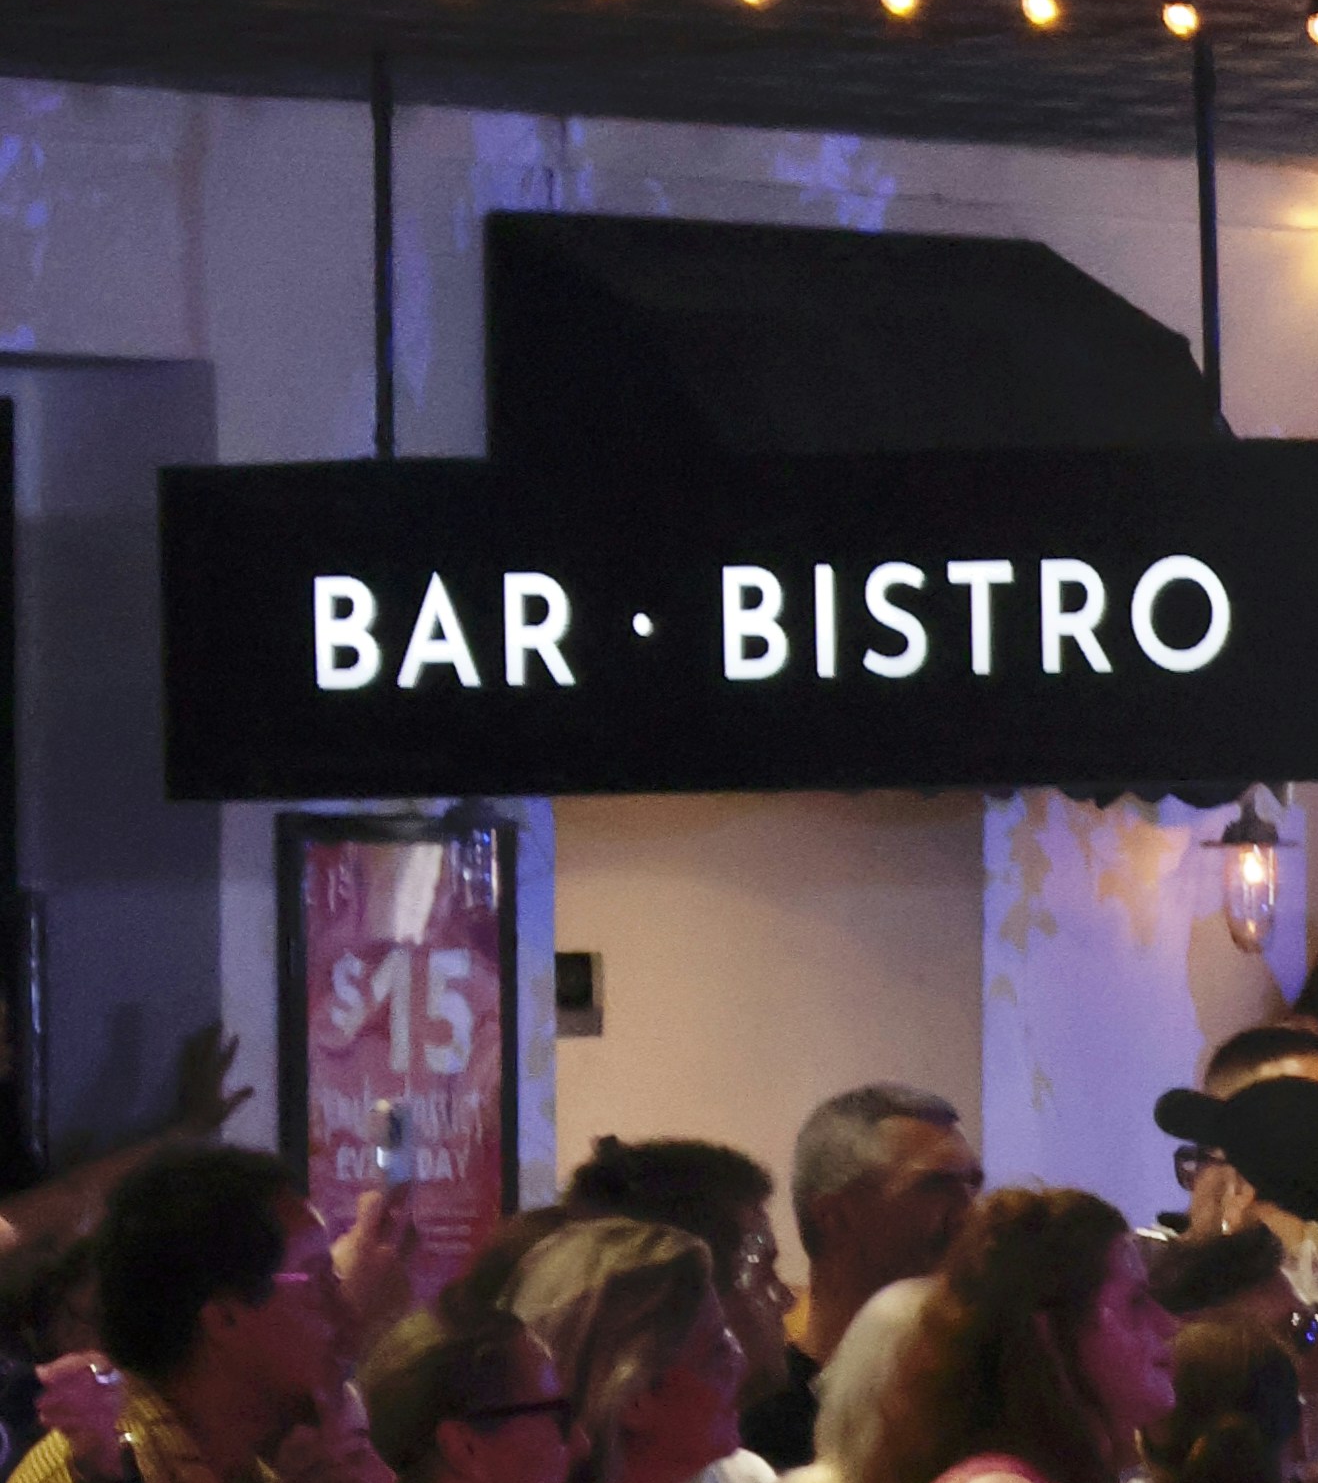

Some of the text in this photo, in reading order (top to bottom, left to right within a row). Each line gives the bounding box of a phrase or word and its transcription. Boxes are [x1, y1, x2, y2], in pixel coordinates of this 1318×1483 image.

[312, 571, 578, 691] BAR
[720, 554, 1232, 680] BISTRO
[330, 948, 474, 1076] $15
